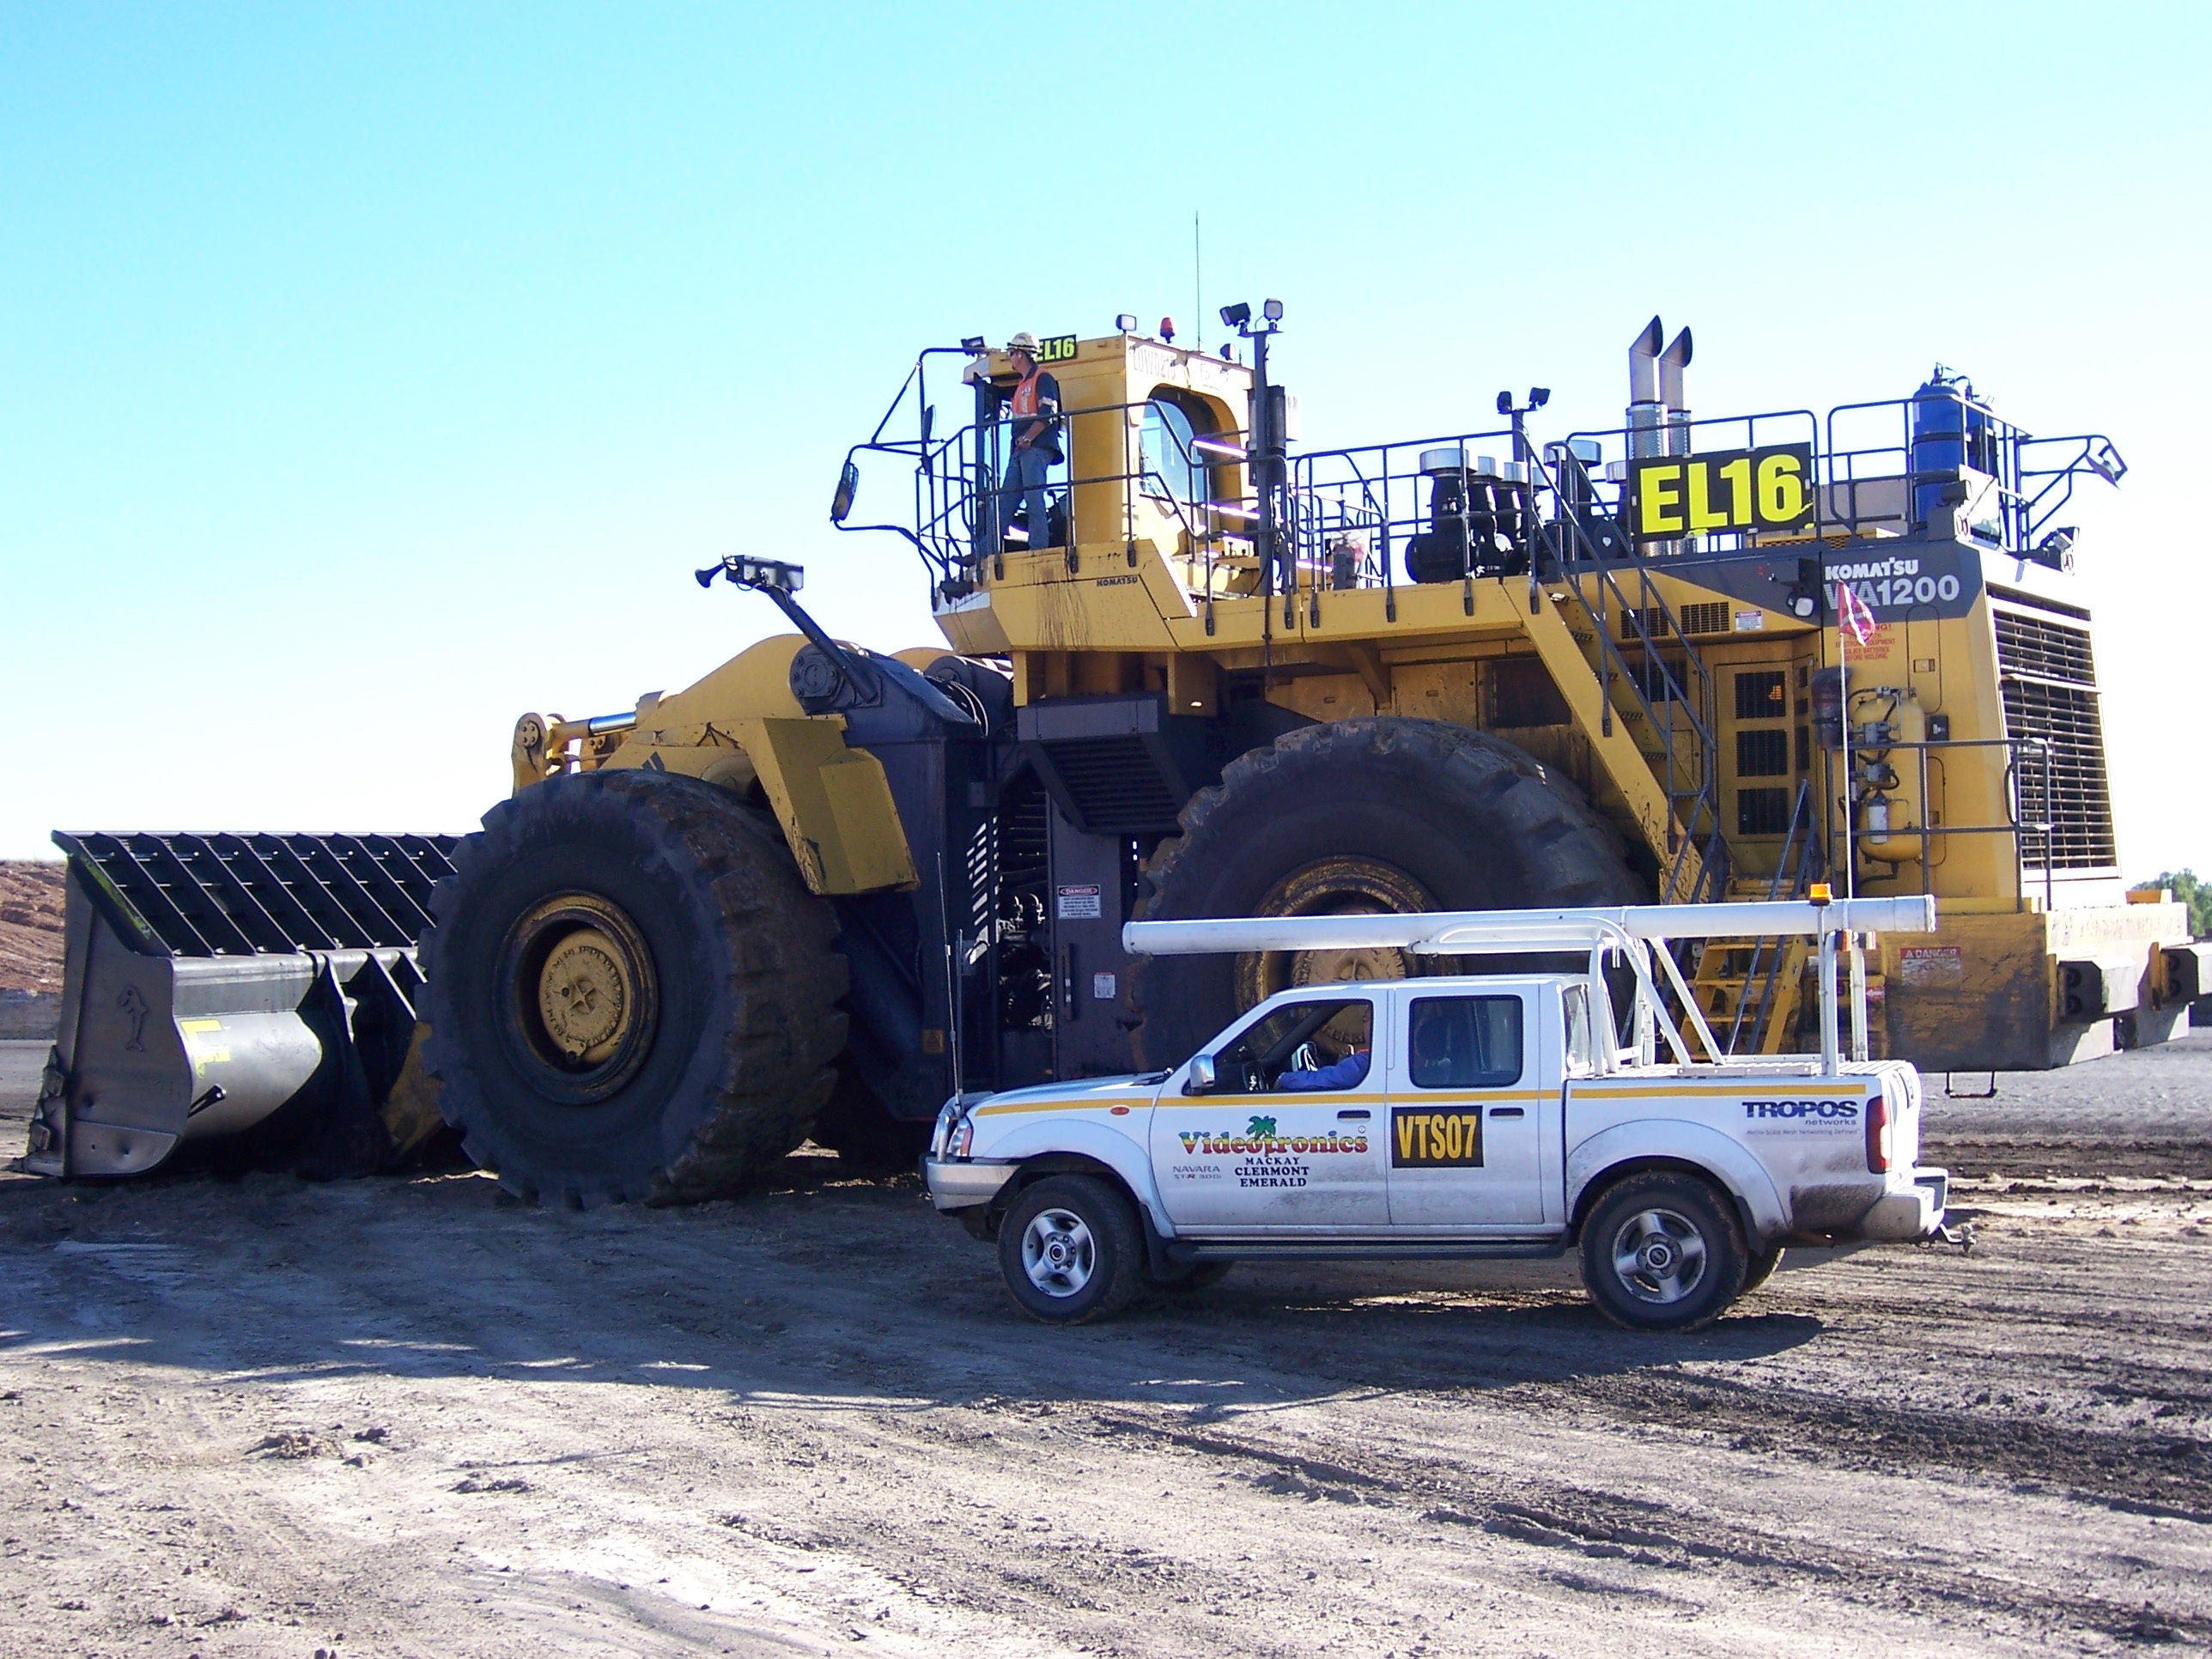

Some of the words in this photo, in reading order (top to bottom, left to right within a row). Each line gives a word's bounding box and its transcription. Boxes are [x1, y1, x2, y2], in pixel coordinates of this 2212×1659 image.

[1035, 337, 1075, 361] EL16
[1639, 453, 1804, 535] EL16
[1825, 556, 1919, 580] KOMATSU
[1096, 576, 1139, 587] KOMATSU
[1823, 574, 1960, 611] WA1200
[1915, 948, 1957, 958] DANGER
[1741, 1100, 1858, 1118] TROPOS
[1178, 1130, 1369, 1157] Videotronics
[1397, 1114, 1479, 1160] VTS07
[1234, 1166, 1310, 1176] CLERMONT
[1245, 1157, 1300, 1165] MACKAY
[1240, 1177, 1307, 1188] EMERALD
